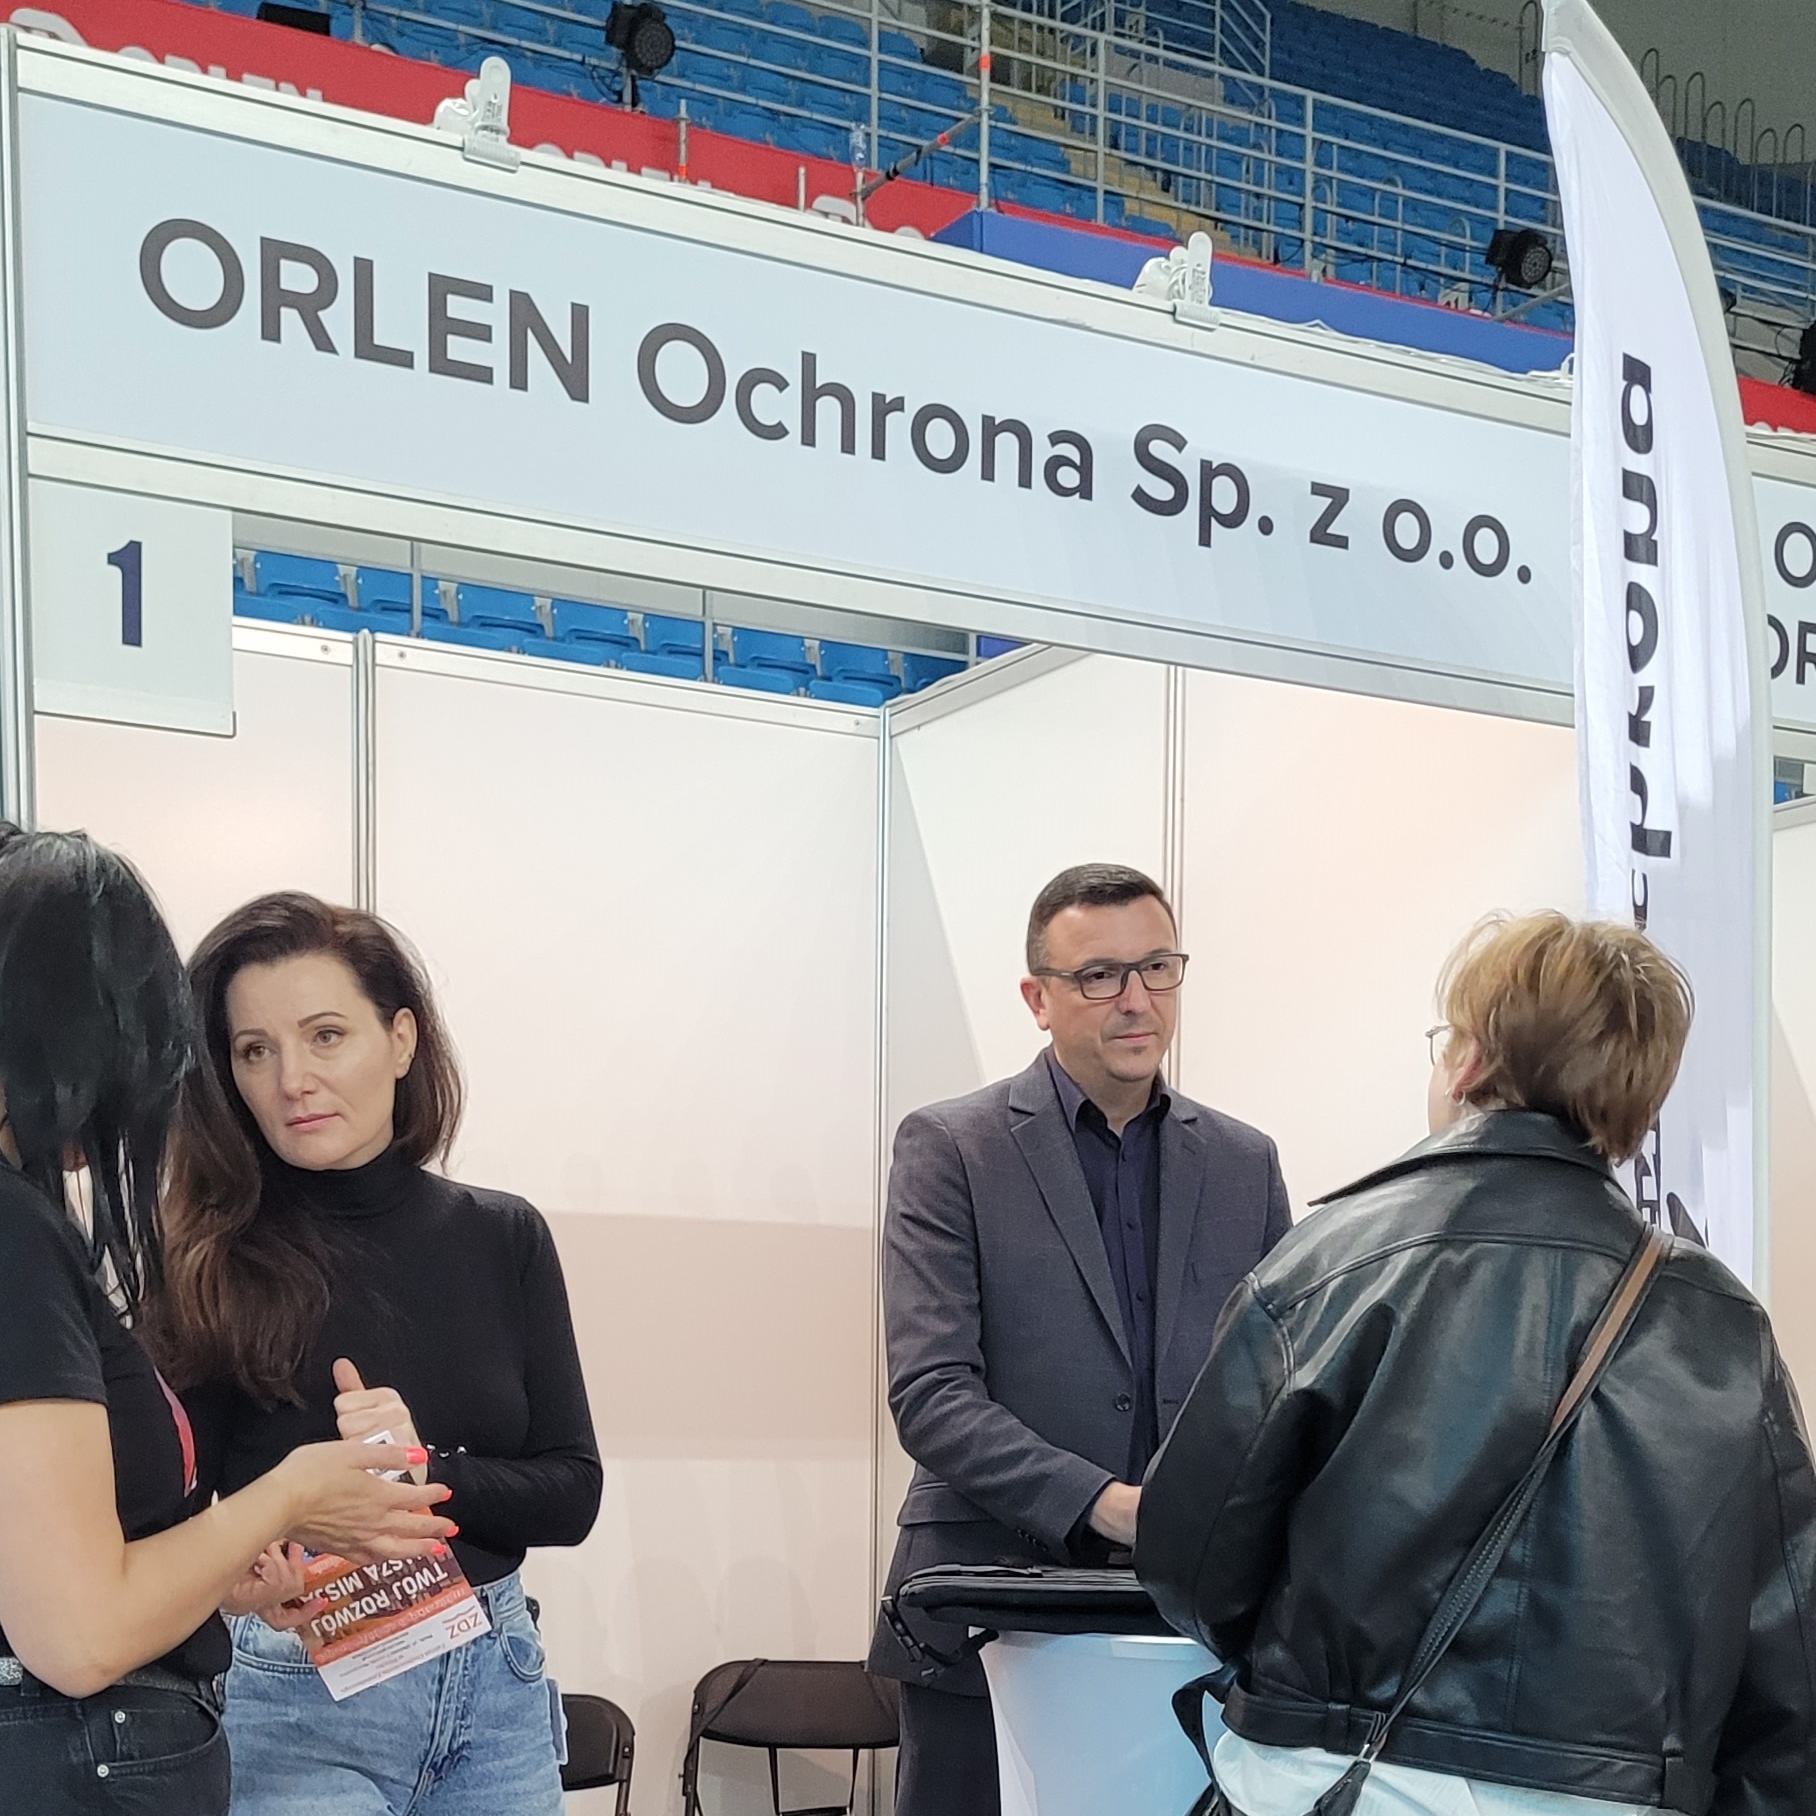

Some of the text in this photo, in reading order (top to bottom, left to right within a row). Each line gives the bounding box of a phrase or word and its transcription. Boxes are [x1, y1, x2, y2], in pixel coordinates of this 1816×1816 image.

[139, 218, 1532, 585] ORLEN Ochrona Sp. z o.o.
[106, 539, 142, 648] 1
[362, 1556, 423, 1582] SZA
[391, 1561, 449, 1600] TWÓJ
[310, 1588, 391, 1637] ROZWÓJ
[445, 1611, 483, 1640] ZDZ
